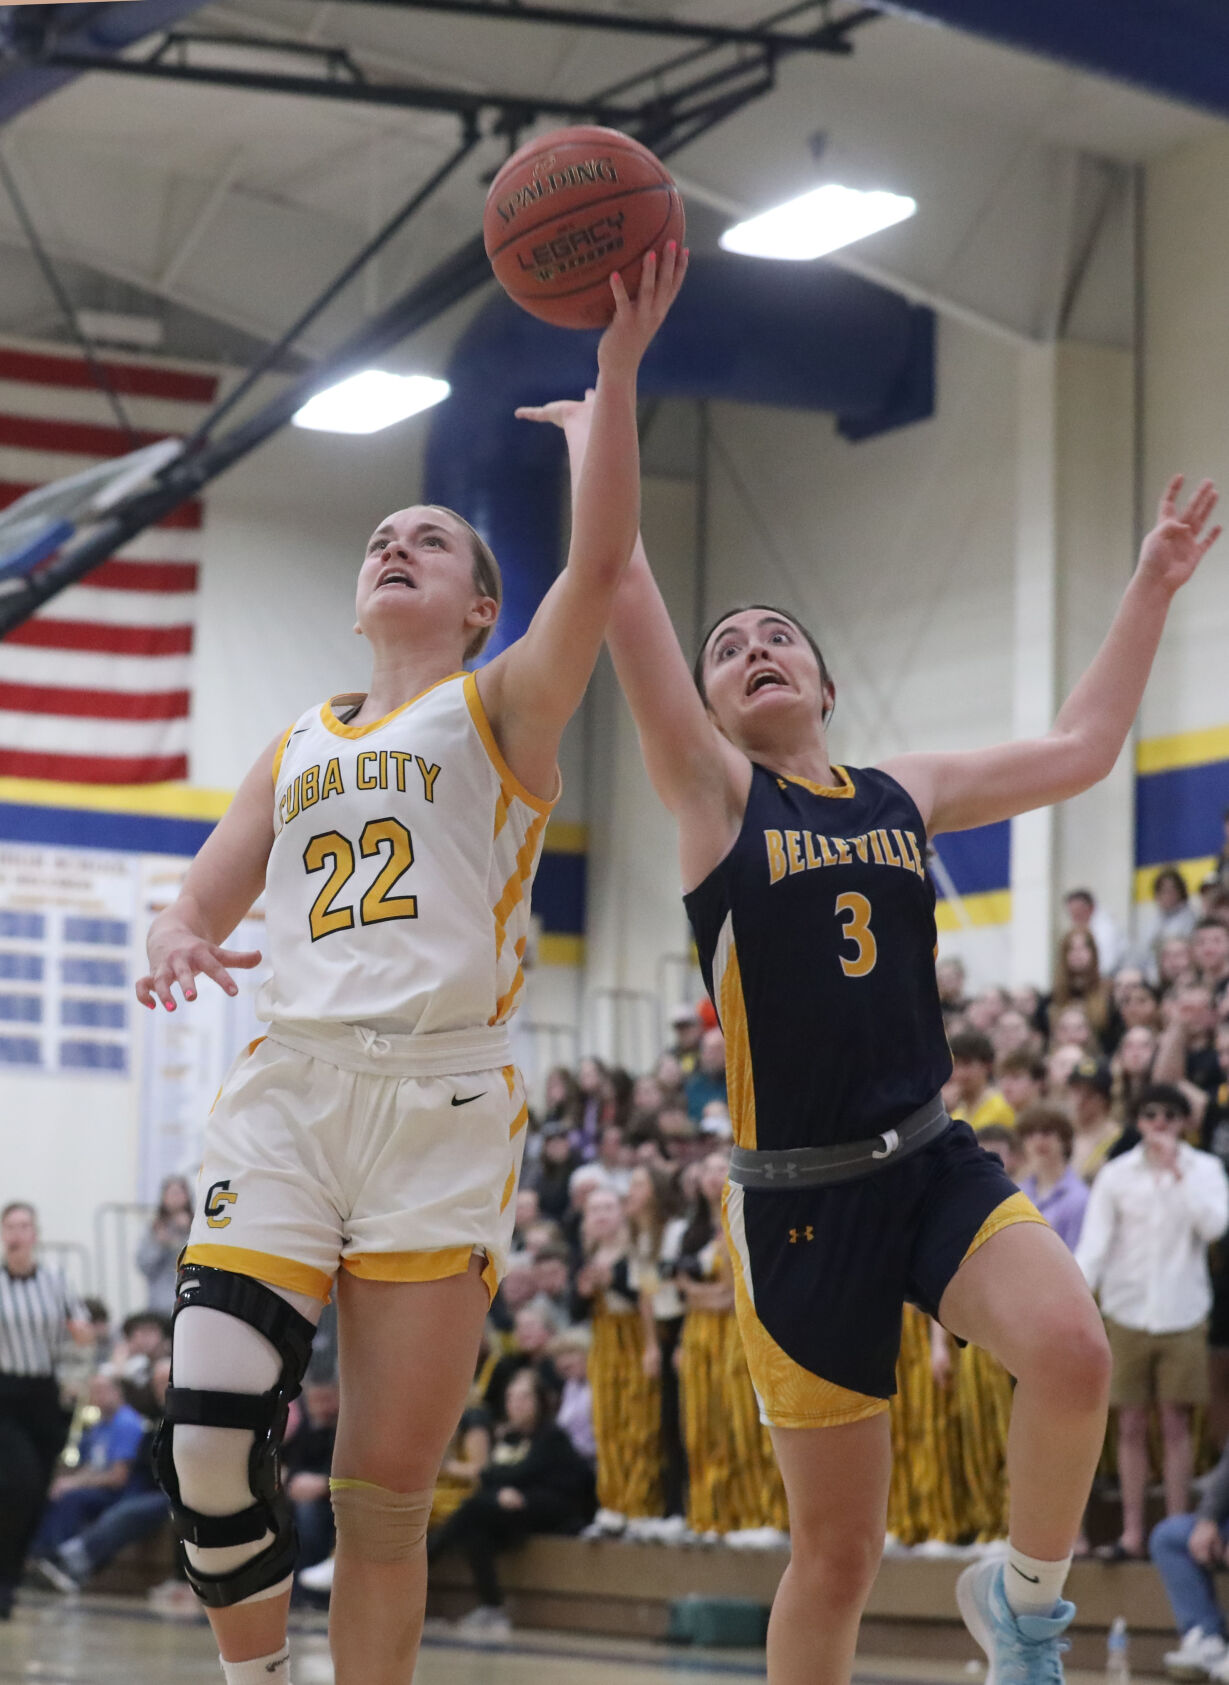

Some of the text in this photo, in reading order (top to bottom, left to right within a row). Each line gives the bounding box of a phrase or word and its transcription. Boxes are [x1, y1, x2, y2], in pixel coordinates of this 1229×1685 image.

[496, 157, 619, 224] SPALDING
[516, 212, 625, 271] LEGACY
[356, 750, 442, 804] CITY
[302, 816, 418, 943] 22
[763, 829, 926, 885] BELLEVILLE
[834, 891, 877, 978] 3
